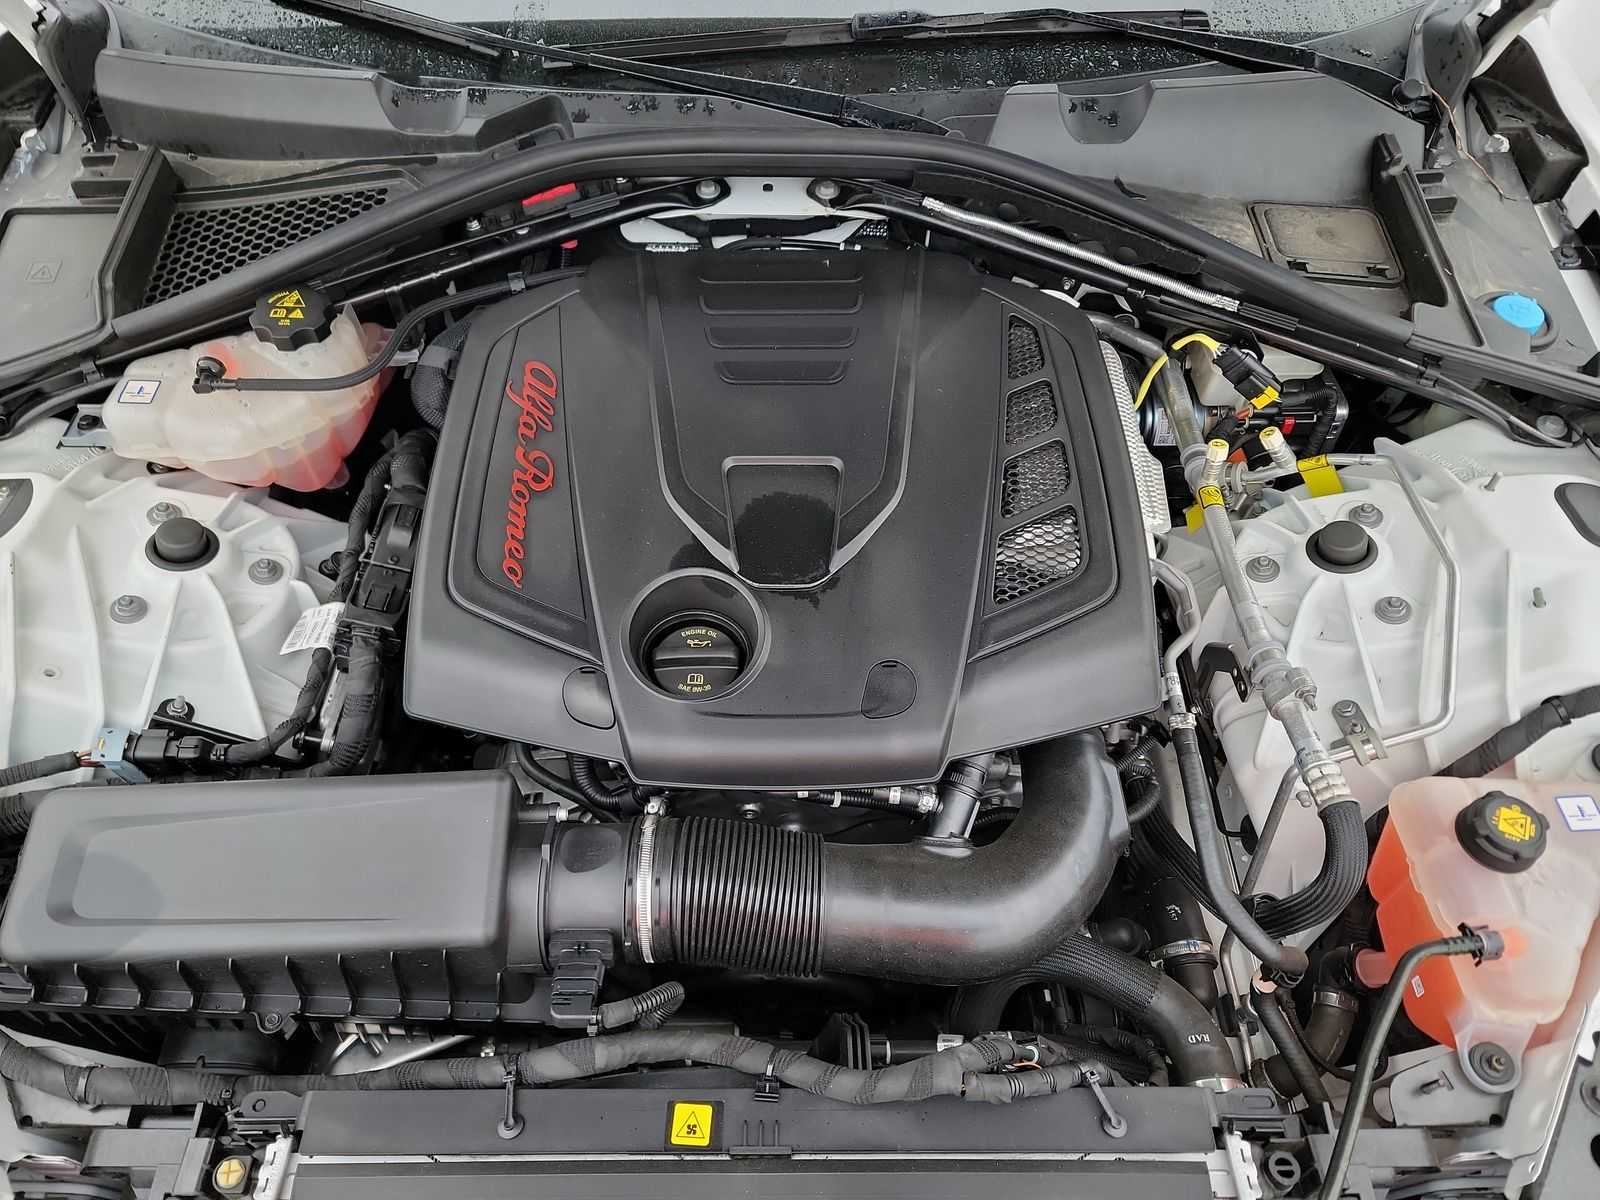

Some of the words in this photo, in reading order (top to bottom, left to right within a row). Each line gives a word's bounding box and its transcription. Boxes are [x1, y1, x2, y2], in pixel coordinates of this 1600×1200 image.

[506, 360, 558, 448] Alfa
[503, 446, 554, 589] Romeo
[681, 629, 706, 637] ENGINE
[707, 630, 718, 638] OIL
[678, 683, 691, 692] SAE
[1188, 1033, 1210, 1044] RAD
